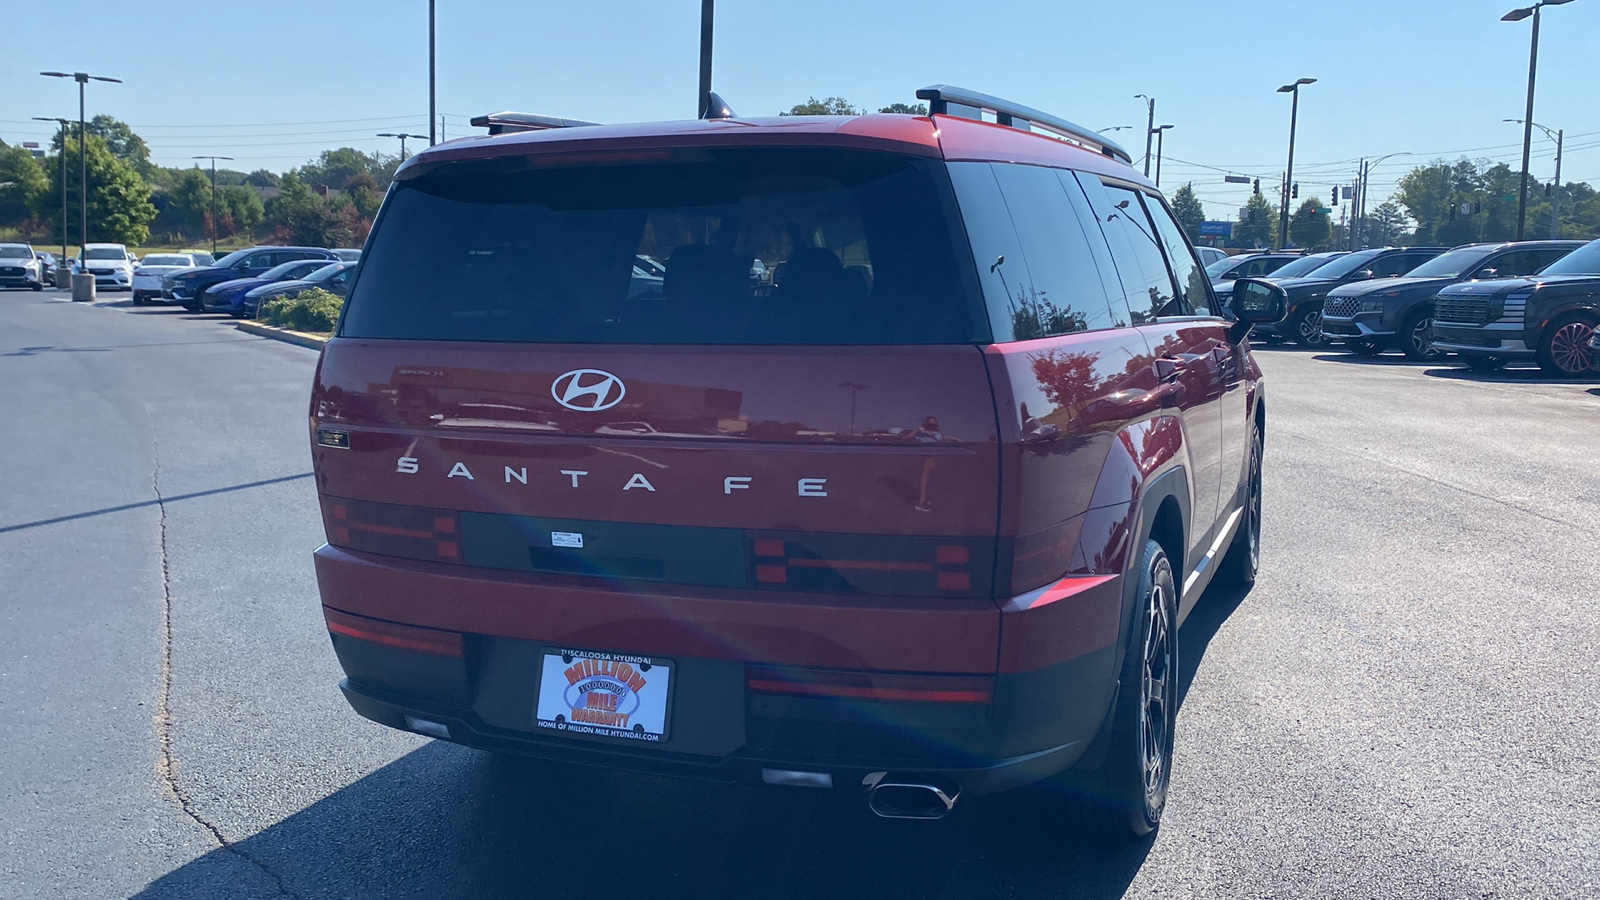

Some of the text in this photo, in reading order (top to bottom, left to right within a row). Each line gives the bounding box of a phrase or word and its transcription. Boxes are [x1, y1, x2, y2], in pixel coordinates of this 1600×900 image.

[397, 456, 828, 497] SANTA FE
[613, 654, 651, 664] HYUNDAI
[564, 658, 646, 693] MILLION
[587, 692, 618, 712] MILE
[571, 707, 630, 728] WARRANTY
[538, 721, 556, 729] HOME
[568, 724, 594, 734] MILLION
[594, 728, 609, 736] MILE
[610, 729, 659, 741] HYUNDAI.COM
